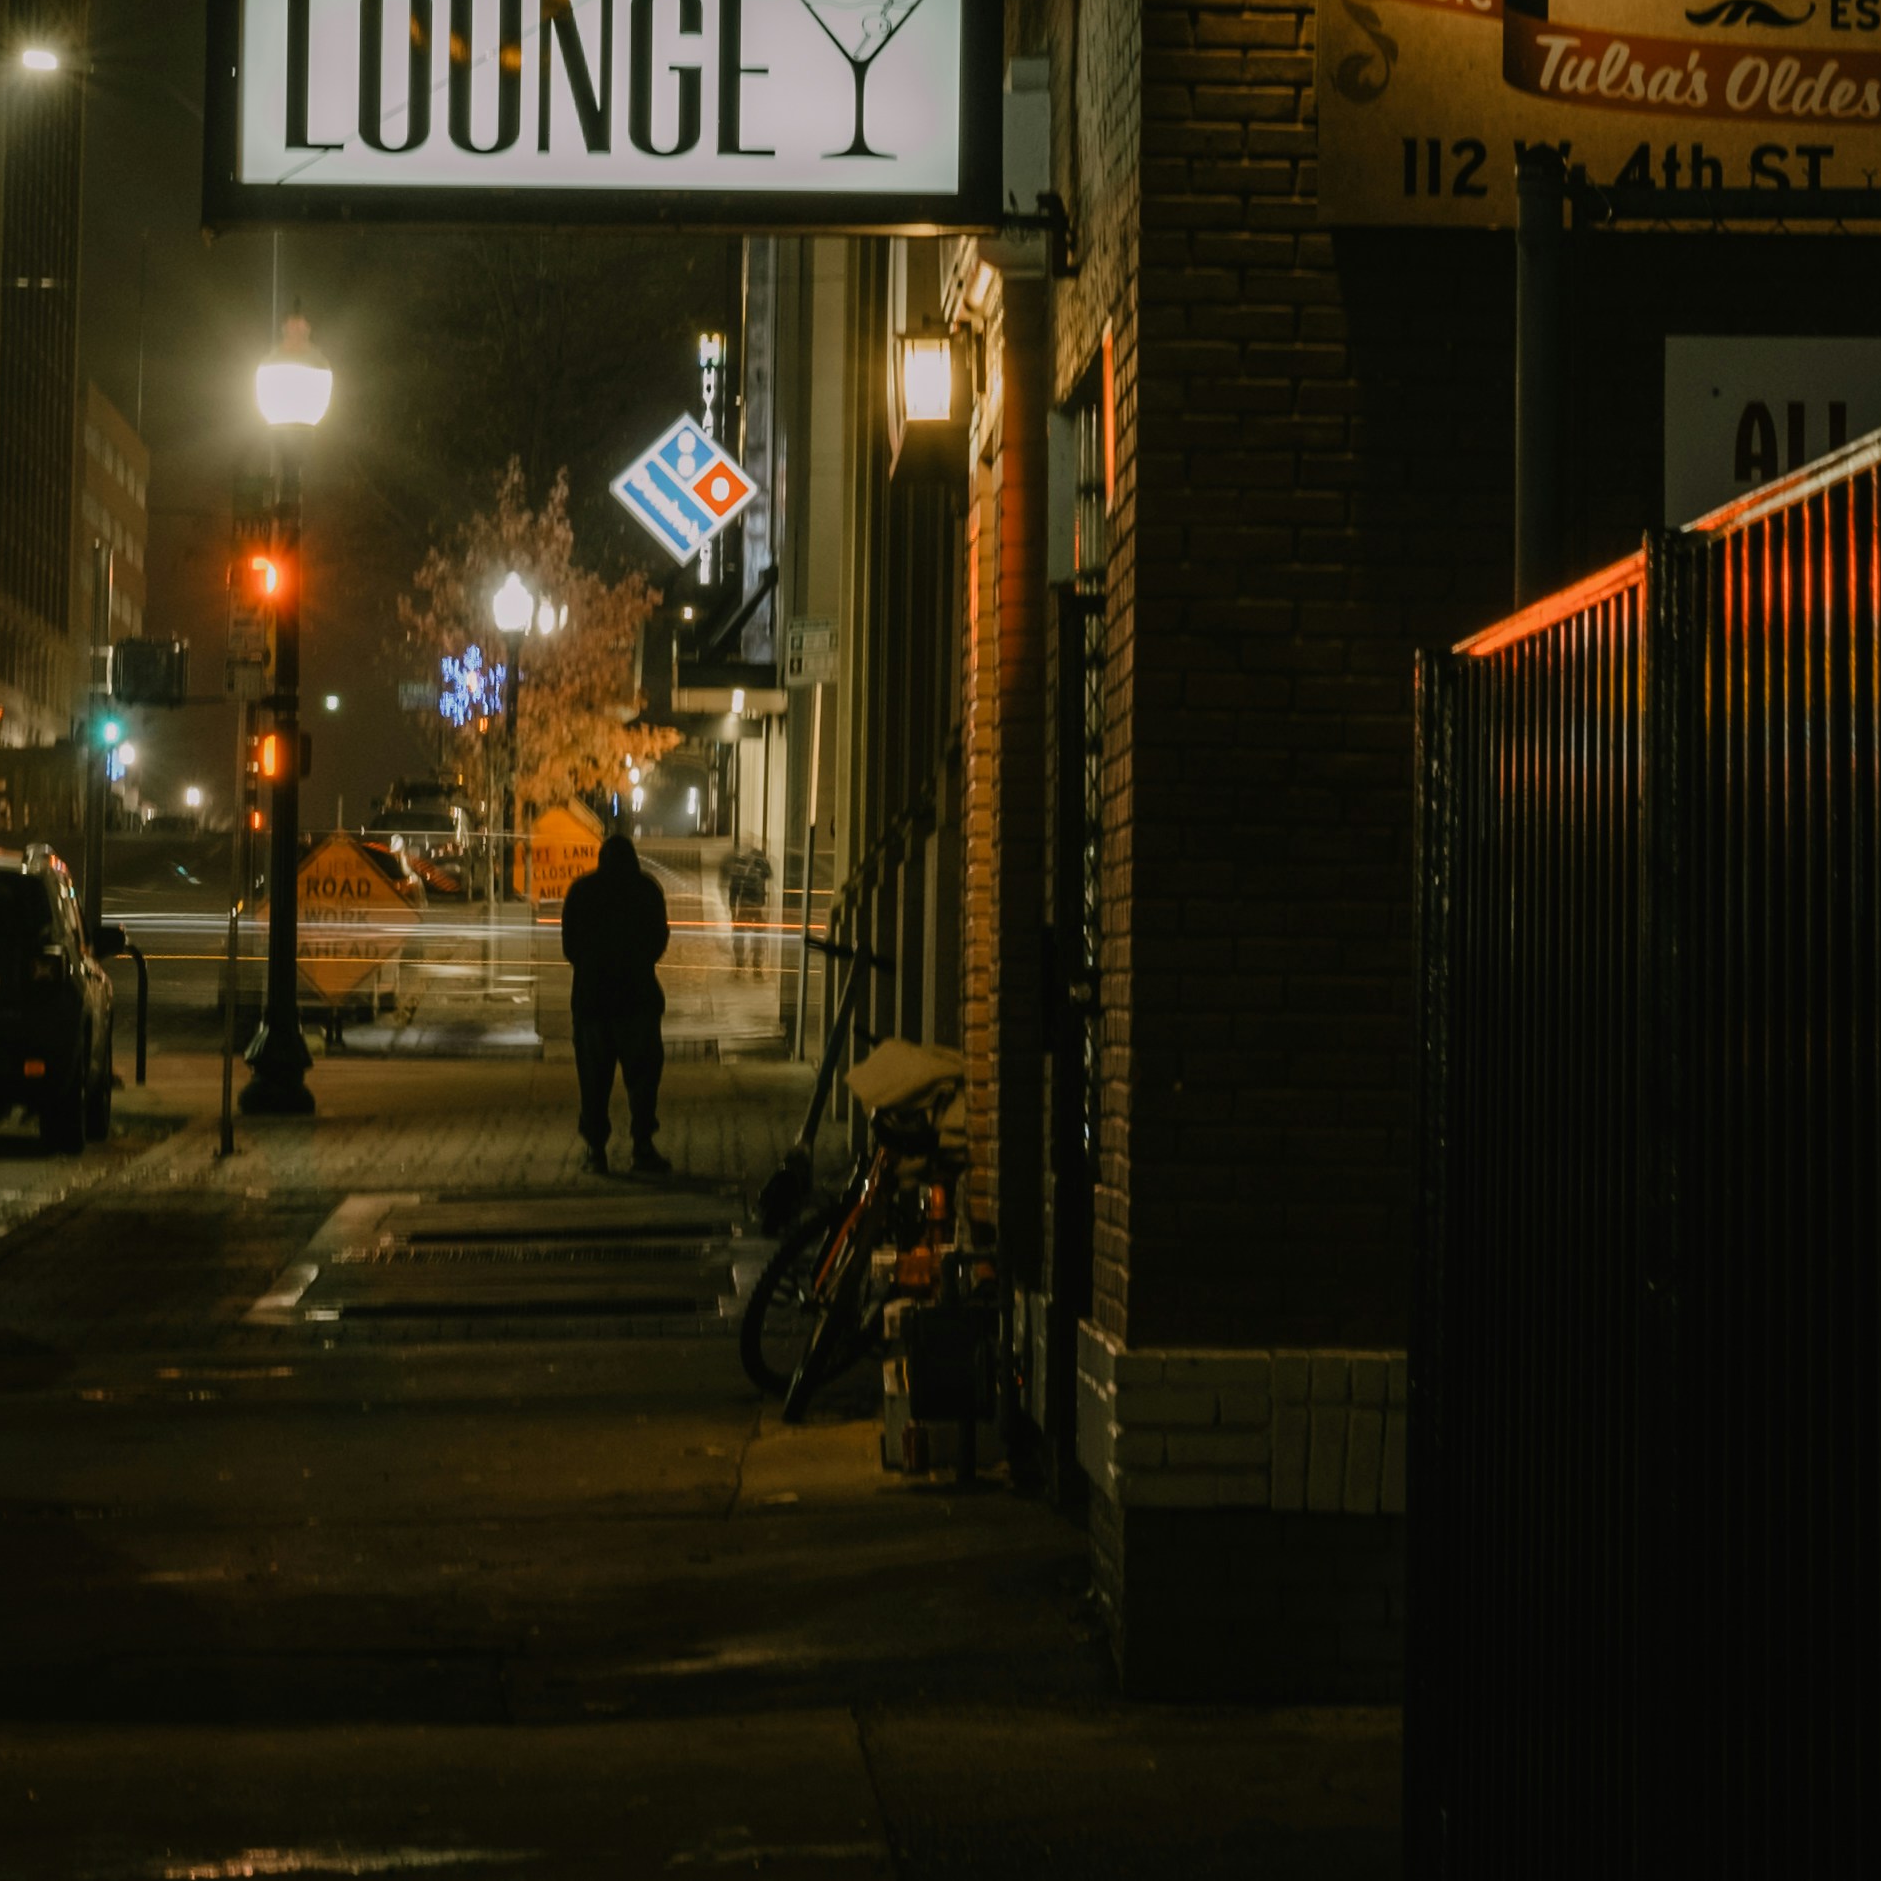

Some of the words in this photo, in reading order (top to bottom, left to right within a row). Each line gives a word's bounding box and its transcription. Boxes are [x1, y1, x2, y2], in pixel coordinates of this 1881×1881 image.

[1534, 33, 1709, 109] Tulsa's
[1402, 137, 1488, 197] 112
[305, 877, 372, 899] ROAD
